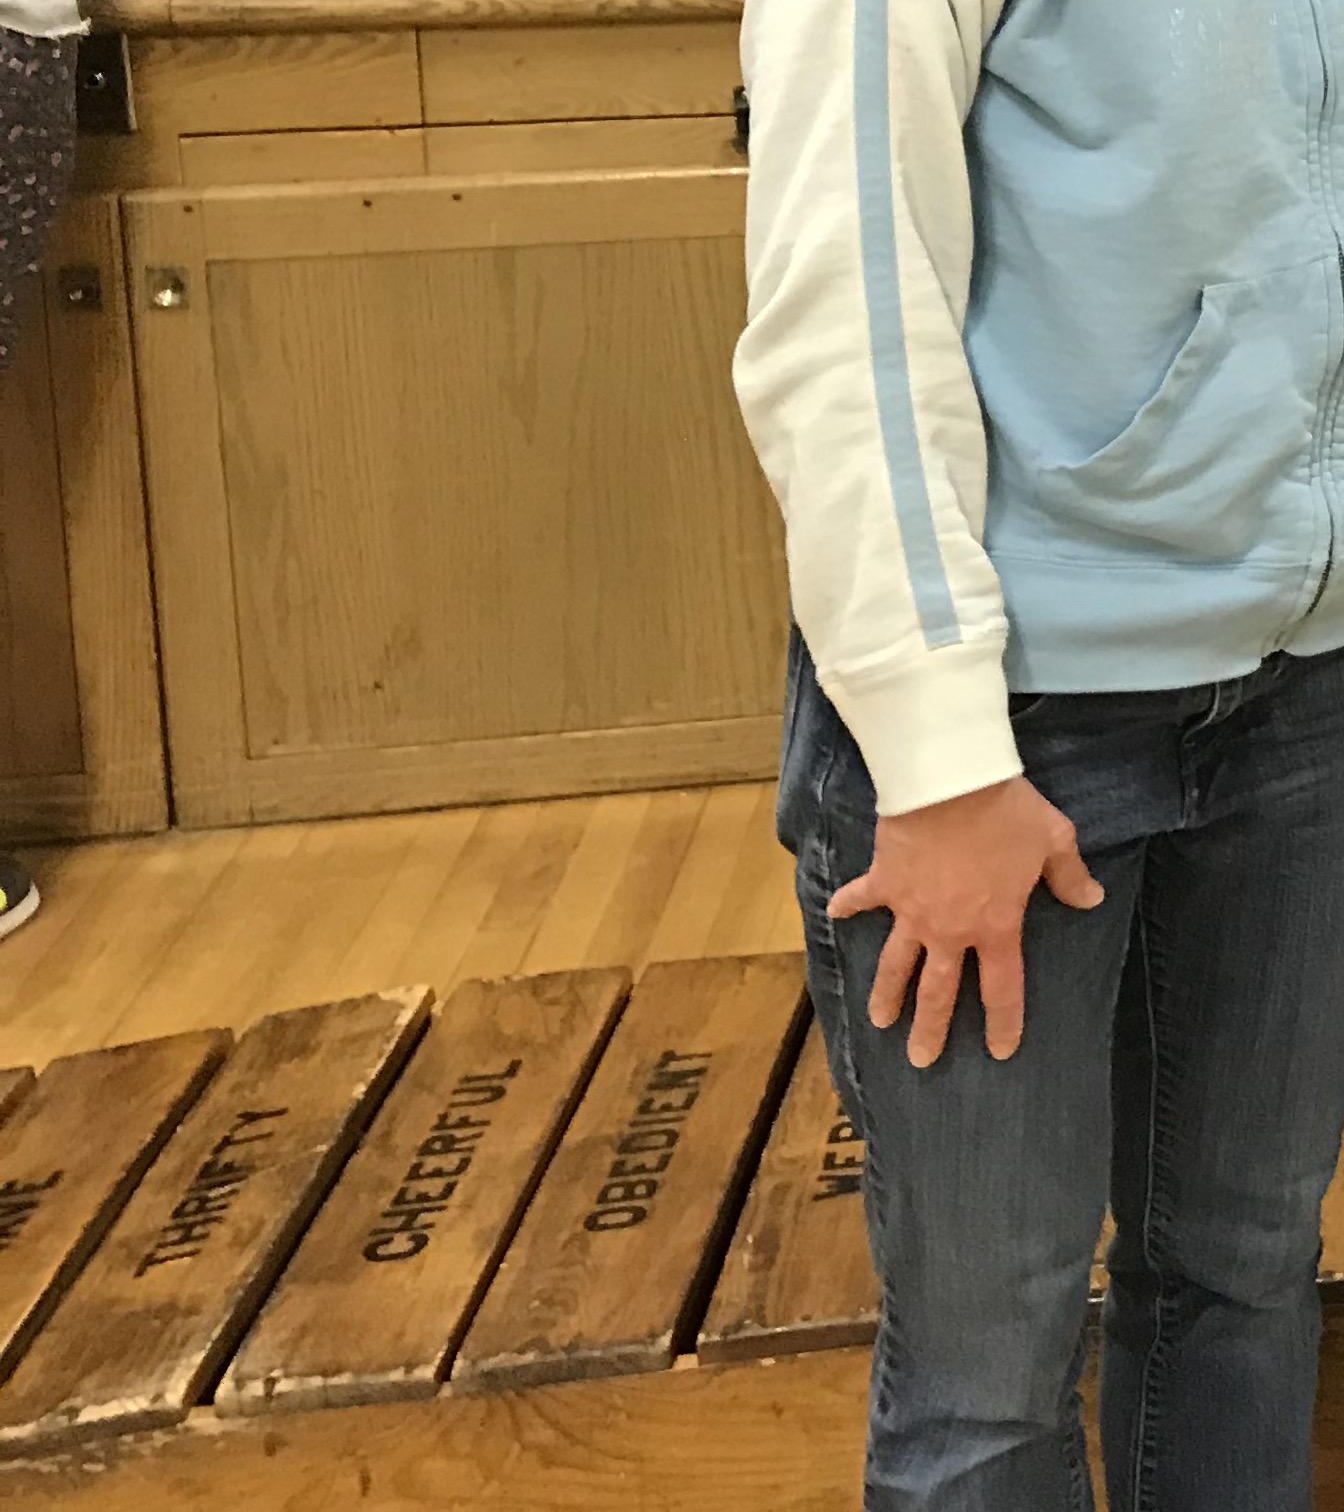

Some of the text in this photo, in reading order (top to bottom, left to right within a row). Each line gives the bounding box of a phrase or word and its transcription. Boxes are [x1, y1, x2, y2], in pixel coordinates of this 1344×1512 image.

[133, 1107, 289, 1278] THRIFTY
[362, 1058, 523, 1262] CHEERFUL
[583, 1049, 713, 1232] OBEDIENT
